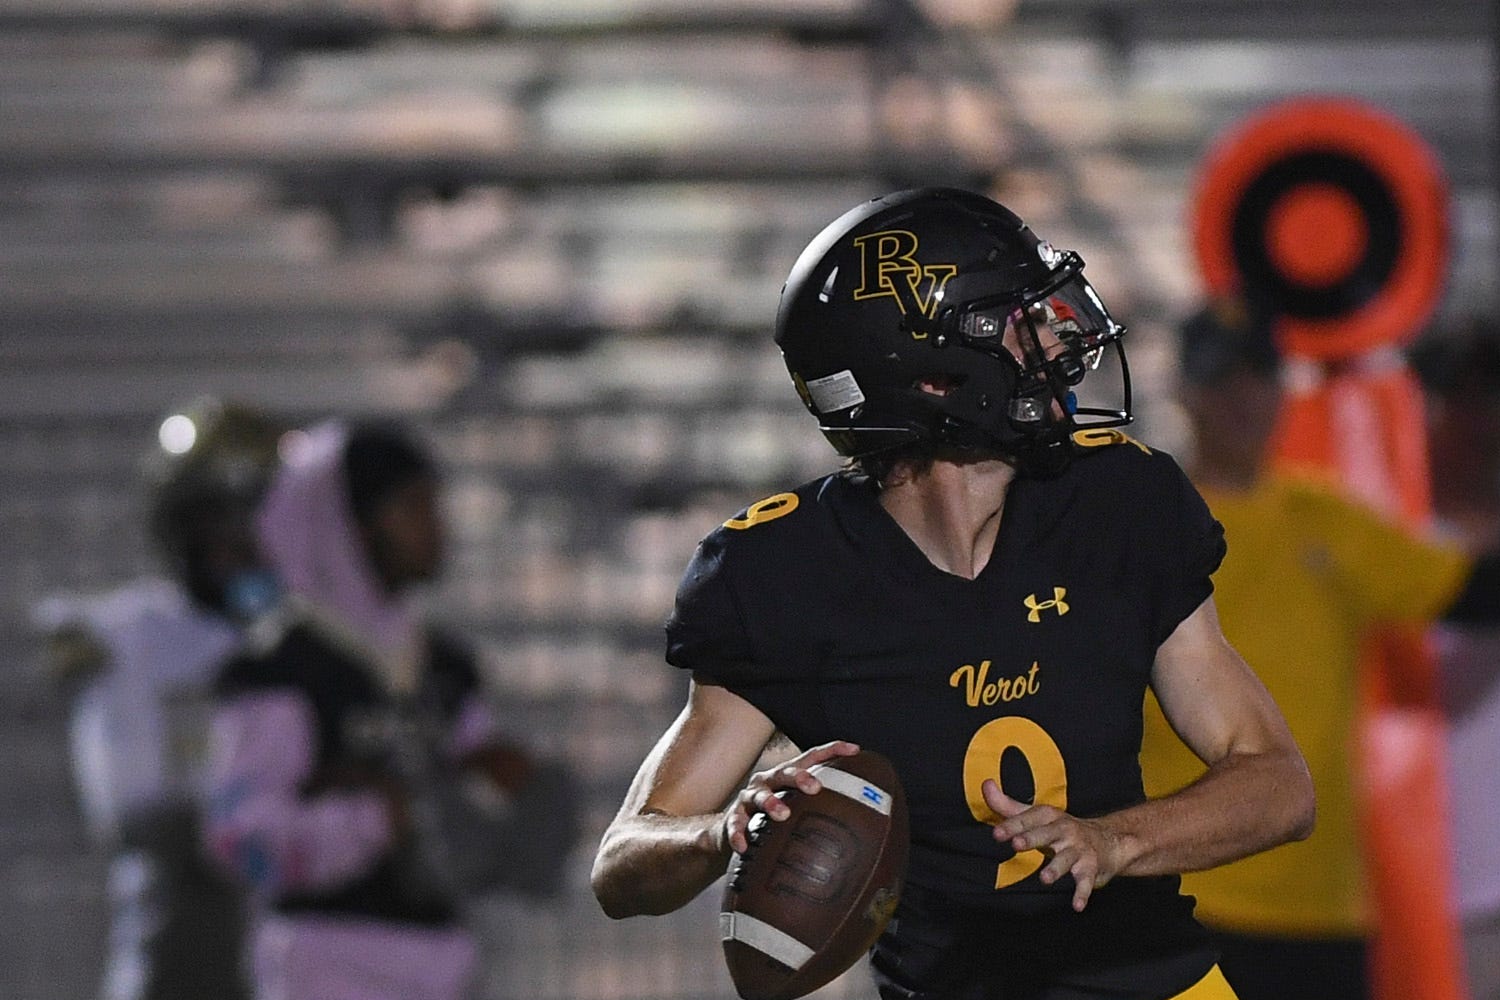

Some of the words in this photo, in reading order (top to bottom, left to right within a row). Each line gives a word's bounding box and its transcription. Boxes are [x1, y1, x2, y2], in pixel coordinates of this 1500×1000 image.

[723, 492, 800, 531] 9
[950, 660, 1041, 707] Verot
[963, 715, 1068, 890] 9
